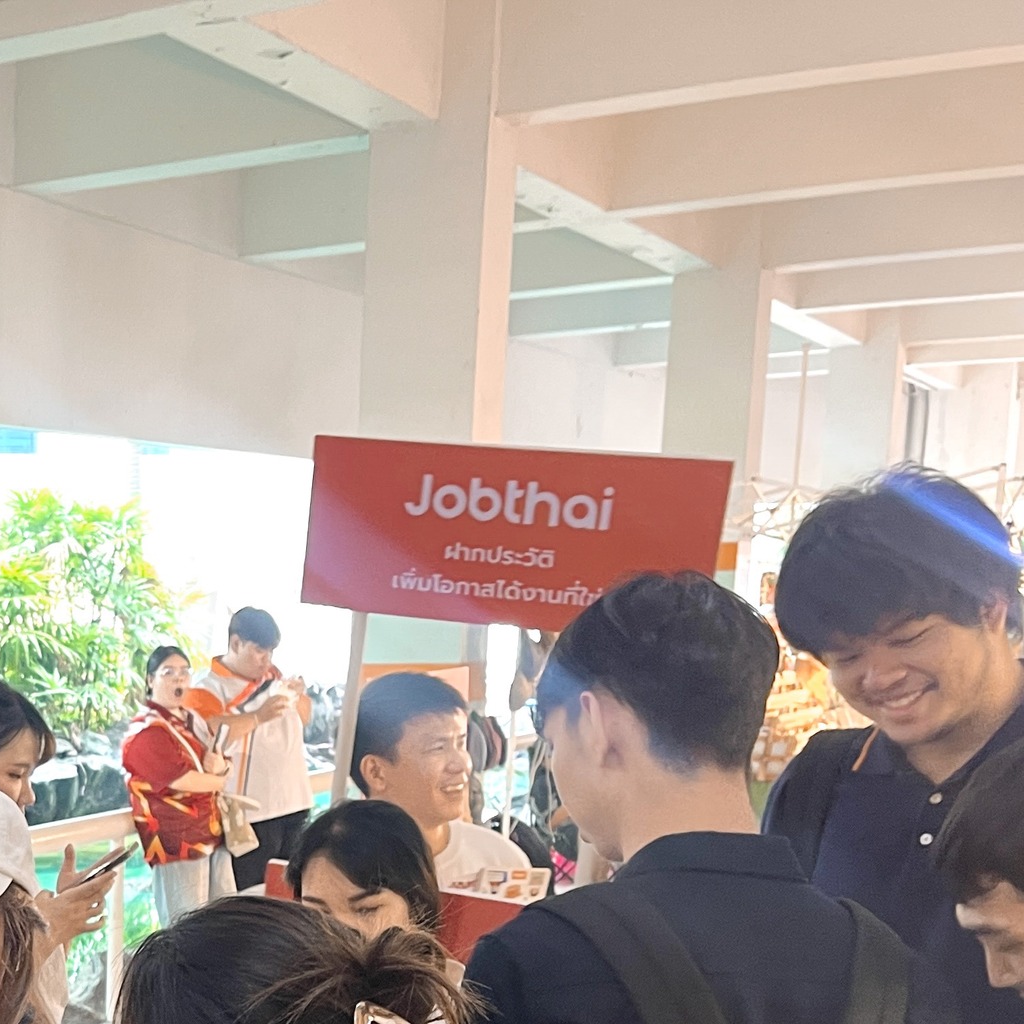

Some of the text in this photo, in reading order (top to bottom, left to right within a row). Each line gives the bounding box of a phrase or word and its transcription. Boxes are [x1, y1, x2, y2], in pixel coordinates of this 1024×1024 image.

[404, 474, 616, 531] Jobthai
[443, 541, 556, 569] ฝากประวัติ
